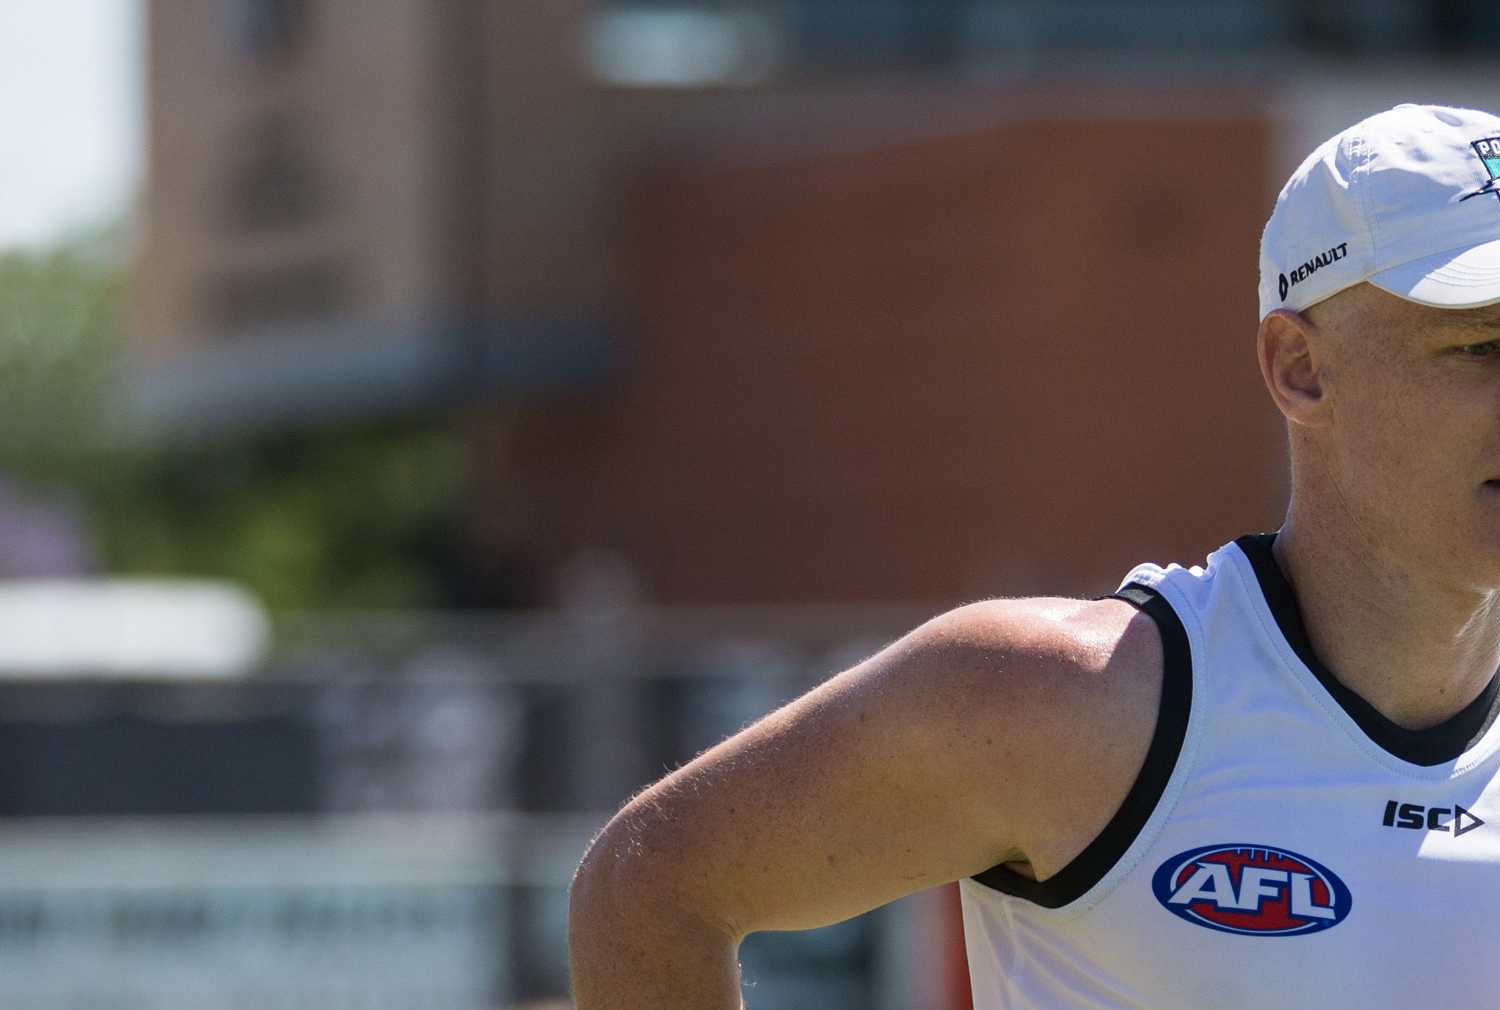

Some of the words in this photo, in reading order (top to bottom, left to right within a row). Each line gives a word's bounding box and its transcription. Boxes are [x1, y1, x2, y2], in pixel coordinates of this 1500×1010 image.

[1290, 241, 1349, 287] RENAULT
[1382, 800, 1452, 832] ISC
[1166, 861, 1337, 921] AFL
